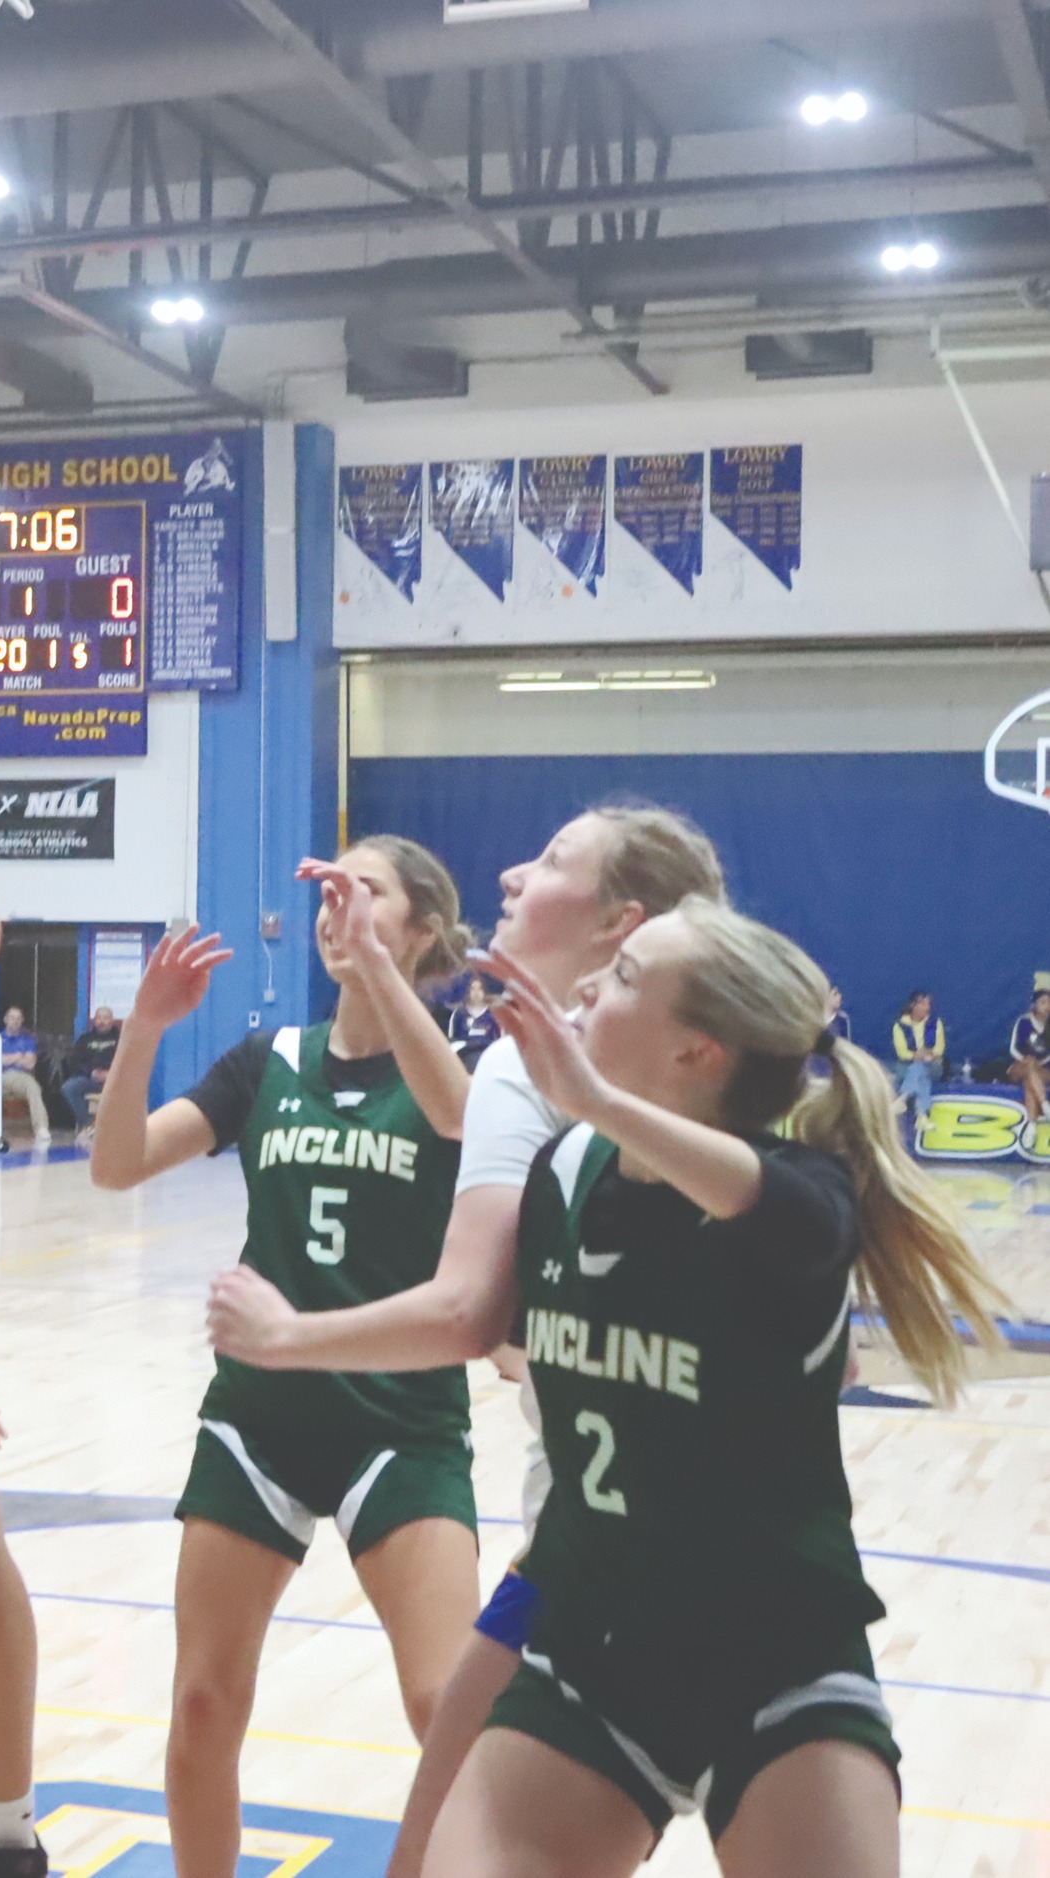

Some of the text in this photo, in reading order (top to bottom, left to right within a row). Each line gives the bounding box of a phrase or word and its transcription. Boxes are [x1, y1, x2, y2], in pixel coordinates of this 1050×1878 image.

[531, 457, 593, 473] LOWRY
[629, 455, 688, 471] LOWRY
[724, 446, 788, 463] LOWRY
[62, 455, 178, 487] SCHOOL
[170, 502, 215, 518] PLAYER
[3, 568, 45, 583] PERIOD
[76, 554, 132, 576] GUEST
[24, 586, 33, 616] 1
[111, 577, 134, 619] 0
[33, 623, 62, 639] FOUL
[100, 621, 137, 637] FOULS
[49, 638, 57, 669] 1
[125, 637, 132, 667] 1
[3, 675, 42, 690] MATCH
[98, 672, 136, 688] SCORE
[22, 708, 142, 728] NevadaPrep
[54, 725, 107, 741] .com
[24, 790, 99, 819] NIAA
[259, 1126, 419, 1183] INCLINE
[306, 1186, 349, 1266] 5
[526, 1307, 701, 1404] INCLINE
[575, 1408, 628, 1517] 2
